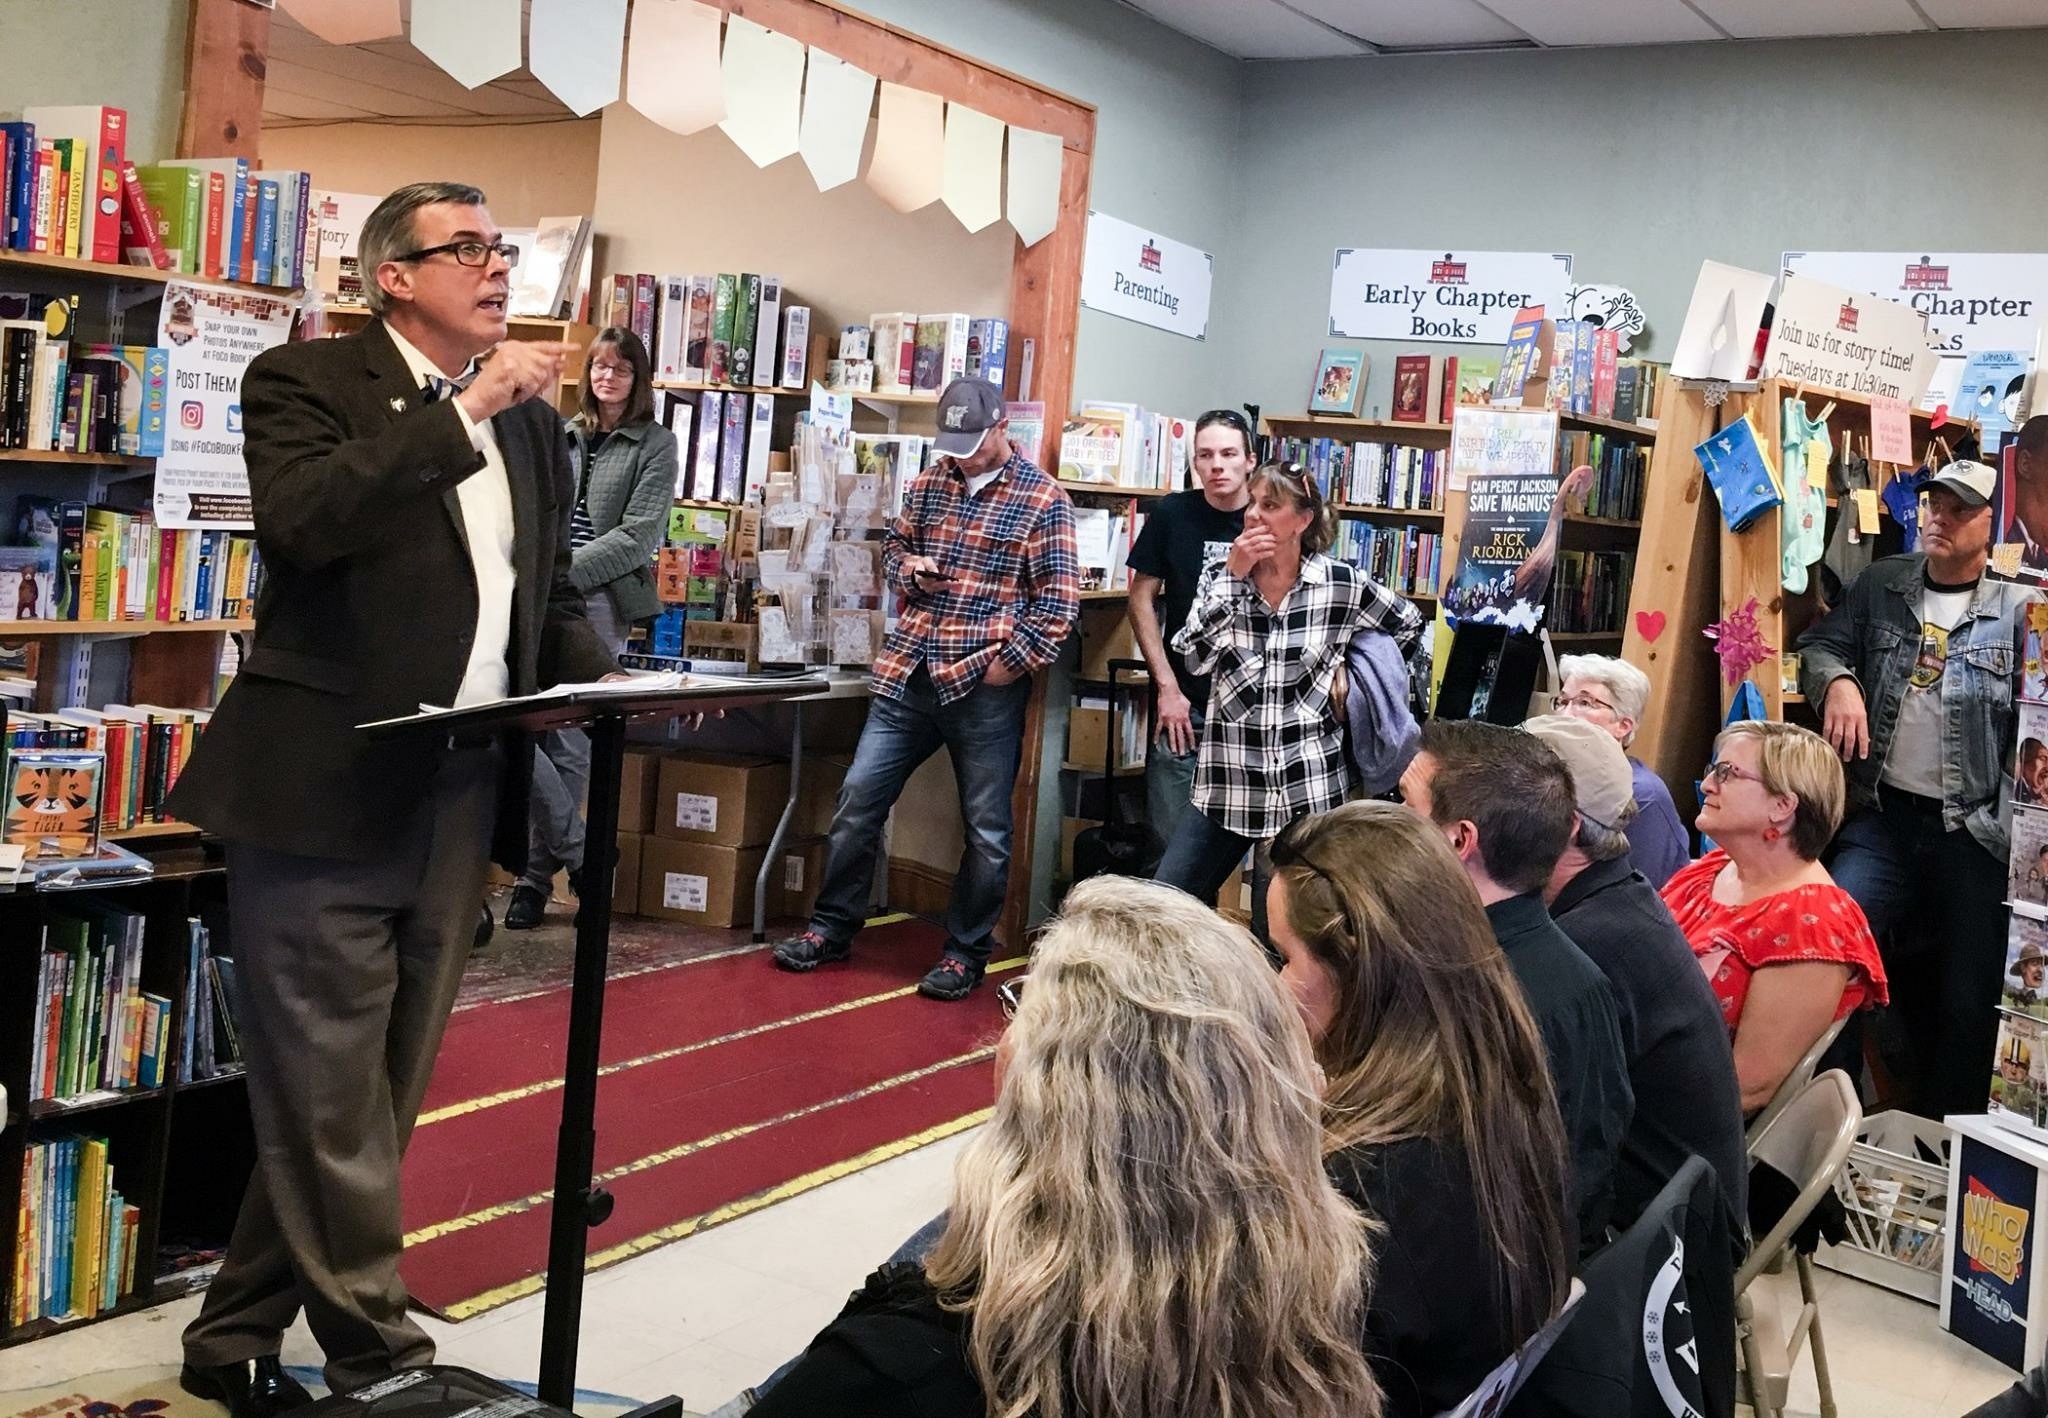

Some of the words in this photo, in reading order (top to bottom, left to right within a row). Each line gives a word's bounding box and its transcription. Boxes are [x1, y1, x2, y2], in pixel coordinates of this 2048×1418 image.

[69, 168, 82, 230] JAMBERRY
[235, 192, 244, 208] fly!
[136, 196, 146, 212] wild
[142, 213, 156, 244] animals
[244, 211, 254, 243] homes
[262, 214, 272, 252] vehicles
[321, 230, 349, 249] tory
[1114, 271, 1179, 316] Parenting
[1364, 284, 1427, 313] Early
[1436, 286, 1532, 316] Chapter
[1911, 292, 2032, 325] Chapter
[223, 322, 240, 334] YOUR
[241, 326, 257, 337] OWN
[1409, 316, 1477, 339] Books
[203, 336, 228, 348] PHOTOS
[229, 338, 265, 351] ANYWHERE
[1778, 319, 1801, 345] Join
[1806, 331, 1820, 349] us
[1822, 331, 1842, 354] for
[1844, 341, 1877, 371] story
[1880, 346, 1914, 372] time!
[202, 350, 211, 359] AT
[230, 353, 246, 364] BOOK
[176, 369, 201, 389] POST
[205, 372, 237, 393] THEM
[1778, 352, 1833, 386] Tuesdays
[1835, 370, 1849, 388] at
[1851, 372, 1900, 399] 10:30am
[171, 439, 189, 452] USING
[1064, 447, 1083, 459] BABY
[1513, 440, 1547, 453] PARTY
[1487, 451, 1542, 464] WRAPPING
[1471, 480, 1488, 494] CAN
[1490, 480, 1519, 493] PERCY
[1520, 479, 1559, 493] JACKSON
[1469, 494, 1497, 512] SAVE
[1493, 533, 1526, 546] RICK
[1472, 546, 1535, 560] RIORDAN
[33, 821, 64, 832] TIGER
[1967, 1190, 2022, 1242] Who
[1963, 1224, 2025, 1280] Was?
[1966, 1277, 2013, 1323] HEAD
